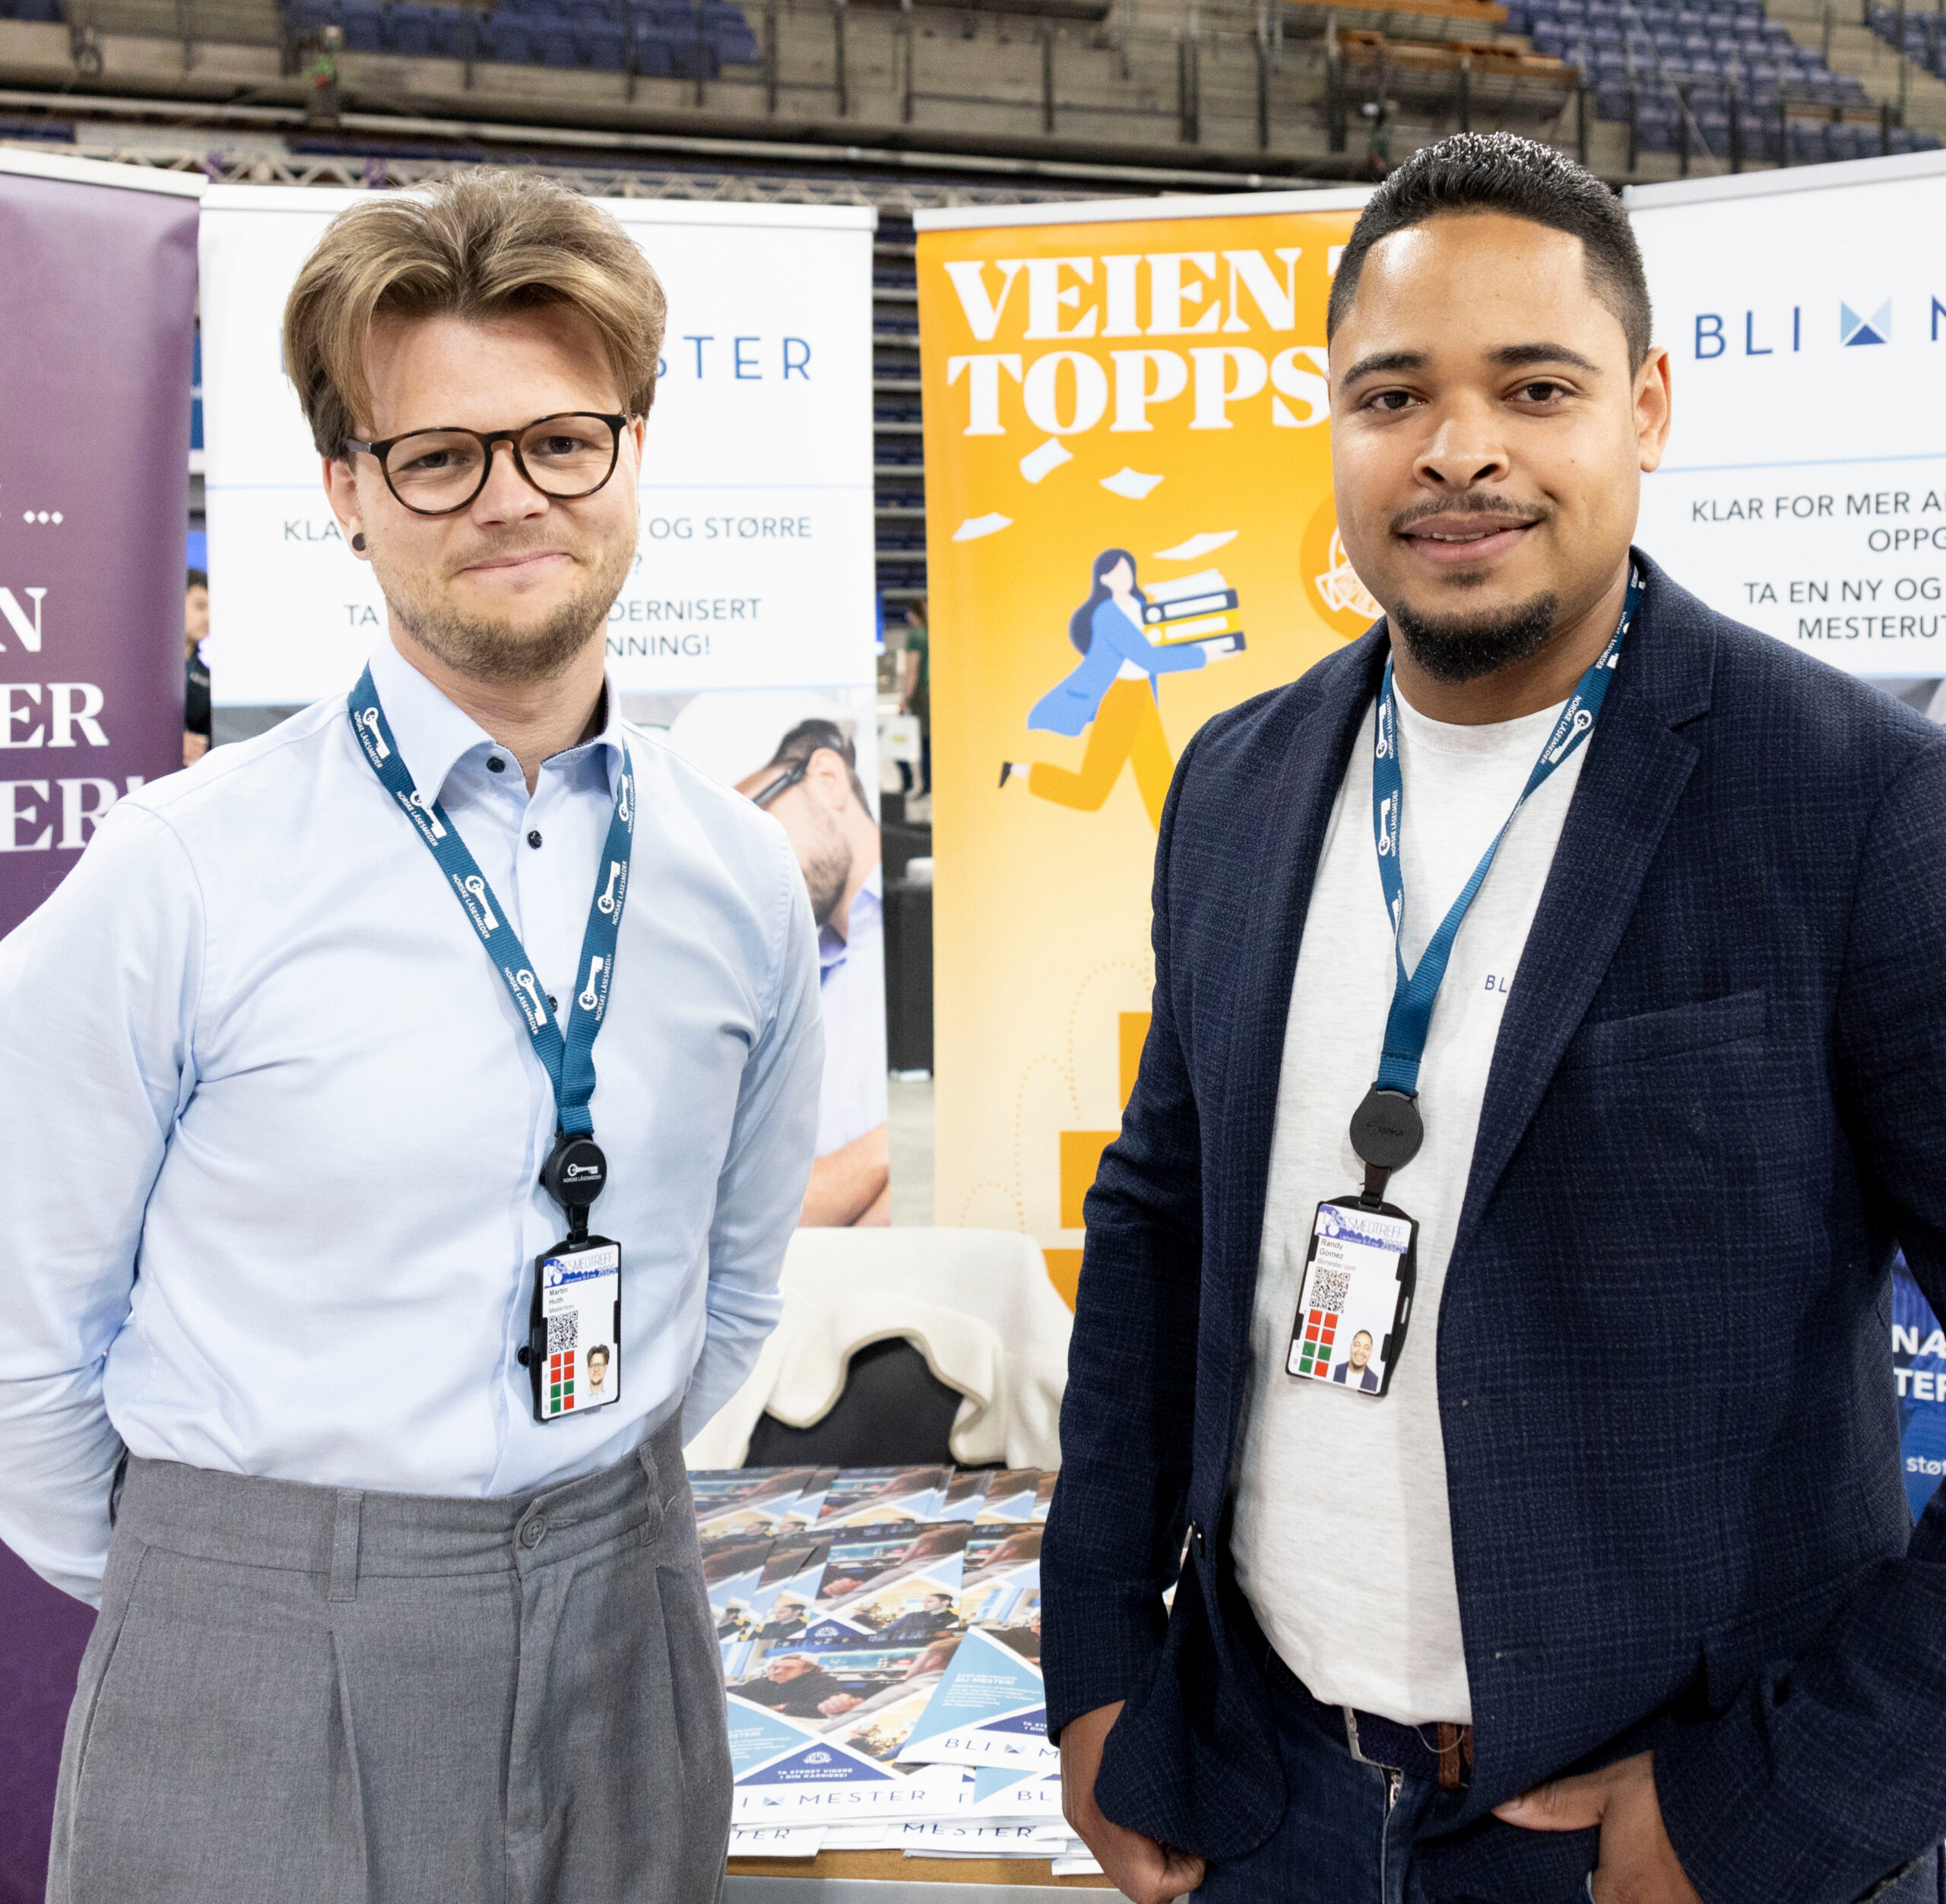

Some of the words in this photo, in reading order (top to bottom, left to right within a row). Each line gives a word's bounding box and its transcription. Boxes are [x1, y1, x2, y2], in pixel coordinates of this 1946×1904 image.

[943, 247, 1303, 341] VEIEN
[1694, 306, 1800, 360] BLI
[947, 346, 1331, 436] TOPPS
[1692, 498, 1764, 522] KLAR
[1775, 495, 1834, 518] FOR
[1846, 492, 1910, 515] MER
[1921, 490, 1946, 512] A
[649, 517, 693, 539] OG
[704, 516, 812, 538] STØRRE
[1744, 582, 1778, 604] TA
[1789, 581, 1829, 603] EN
[1842, 579, 1883, 601] NY
[1894, 577, 1942, 600] OG
[343, 605, 380, 626] TA
[1564, 695, 1582, 722] NORSKE
[360, 732, 383, 768] LÅSESMEDER
[1540, 721, 1569, 765] LÅSESMEDER
[396, 790, 415, 813] NORSKE
[411, 810, 439, 847] LÅSESMEDER
[1390, 789, 1399, 832] LÅSESMEDER
[1388, 832, 1396, 857] NORSKE
[452, 873, 470, 899] NORSKE
[465, 896, 491, 940] LÅSESMEDER
[611, 899, 623, 926] NORSKE
[618, 860, 627, 900] LÅSESMEDER
[504, 967, 521, 992] NORSKE
[516, 990, 539, 1035] LÅSESMEDER
[595, 994, 607, 1022] NORSKE
[601, 953, 612, 994] LÅSESMEDER
[1319, 1248, 1344, 1259] Gomez
[1321, 1239, 1343, 1251] Randy
[550, 1288, 568, 1296] Martin
[799, 1790, 926, 1804] MESTER
